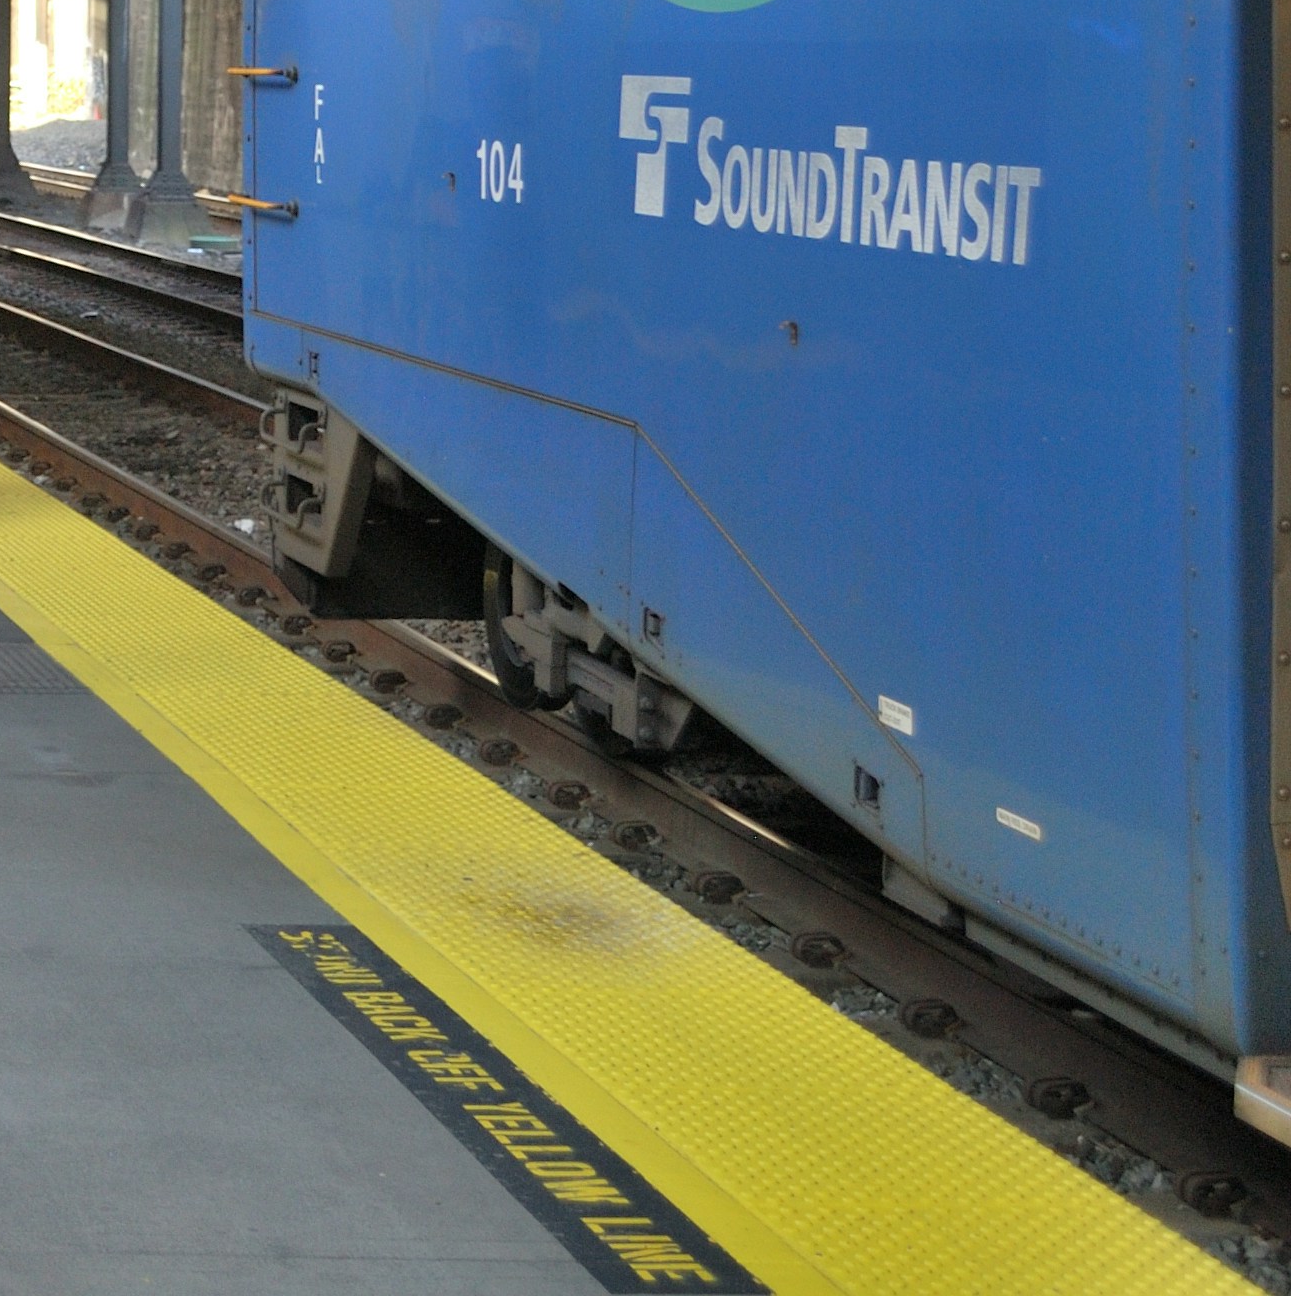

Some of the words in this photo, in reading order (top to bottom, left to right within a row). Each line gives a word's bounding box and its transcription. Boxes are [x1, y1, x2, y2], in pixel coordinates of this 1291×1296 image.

[476, 139, 523, 203] 104
[342, 990, 449, 1042] BACK
[462, 1101, 630, 1205] YELLOW
[580, 1216, 717, 1283] LINE
